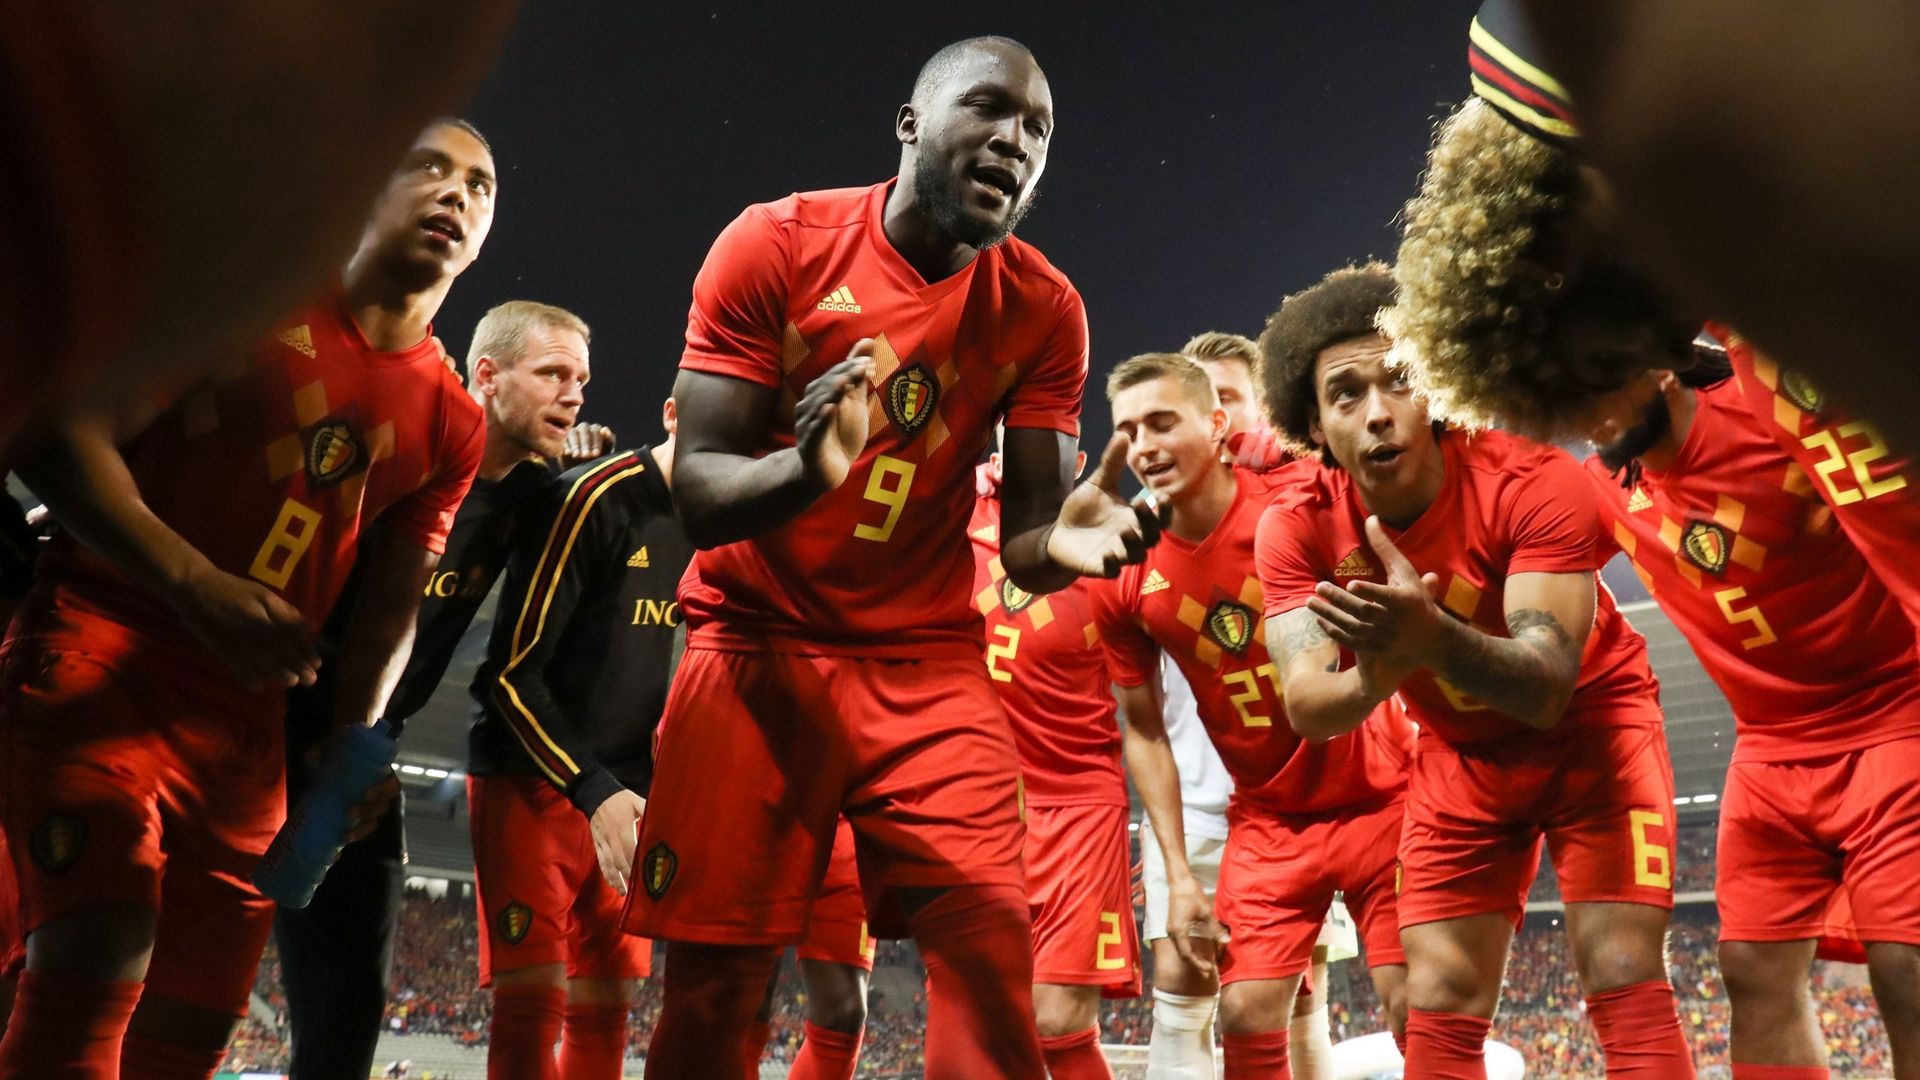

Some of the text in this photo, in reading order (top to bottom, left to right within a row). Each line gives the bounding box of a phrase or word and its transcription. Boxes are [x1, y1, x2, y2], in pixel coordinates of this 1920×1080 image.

[816, 302, 862, 314] adidas
[1800, 421, 1907, 506] 22
[853, 454, 917, 542] 9
[248, 498, 322, 591] 8
[1334, 568, 1374, 577] adidas
[1714, 586, 1777, 650] 5
[986, 624, 1021, 683] 2
[1629, 810, 1671, 889] 6
[1096, 912, 1126, 970] 2
